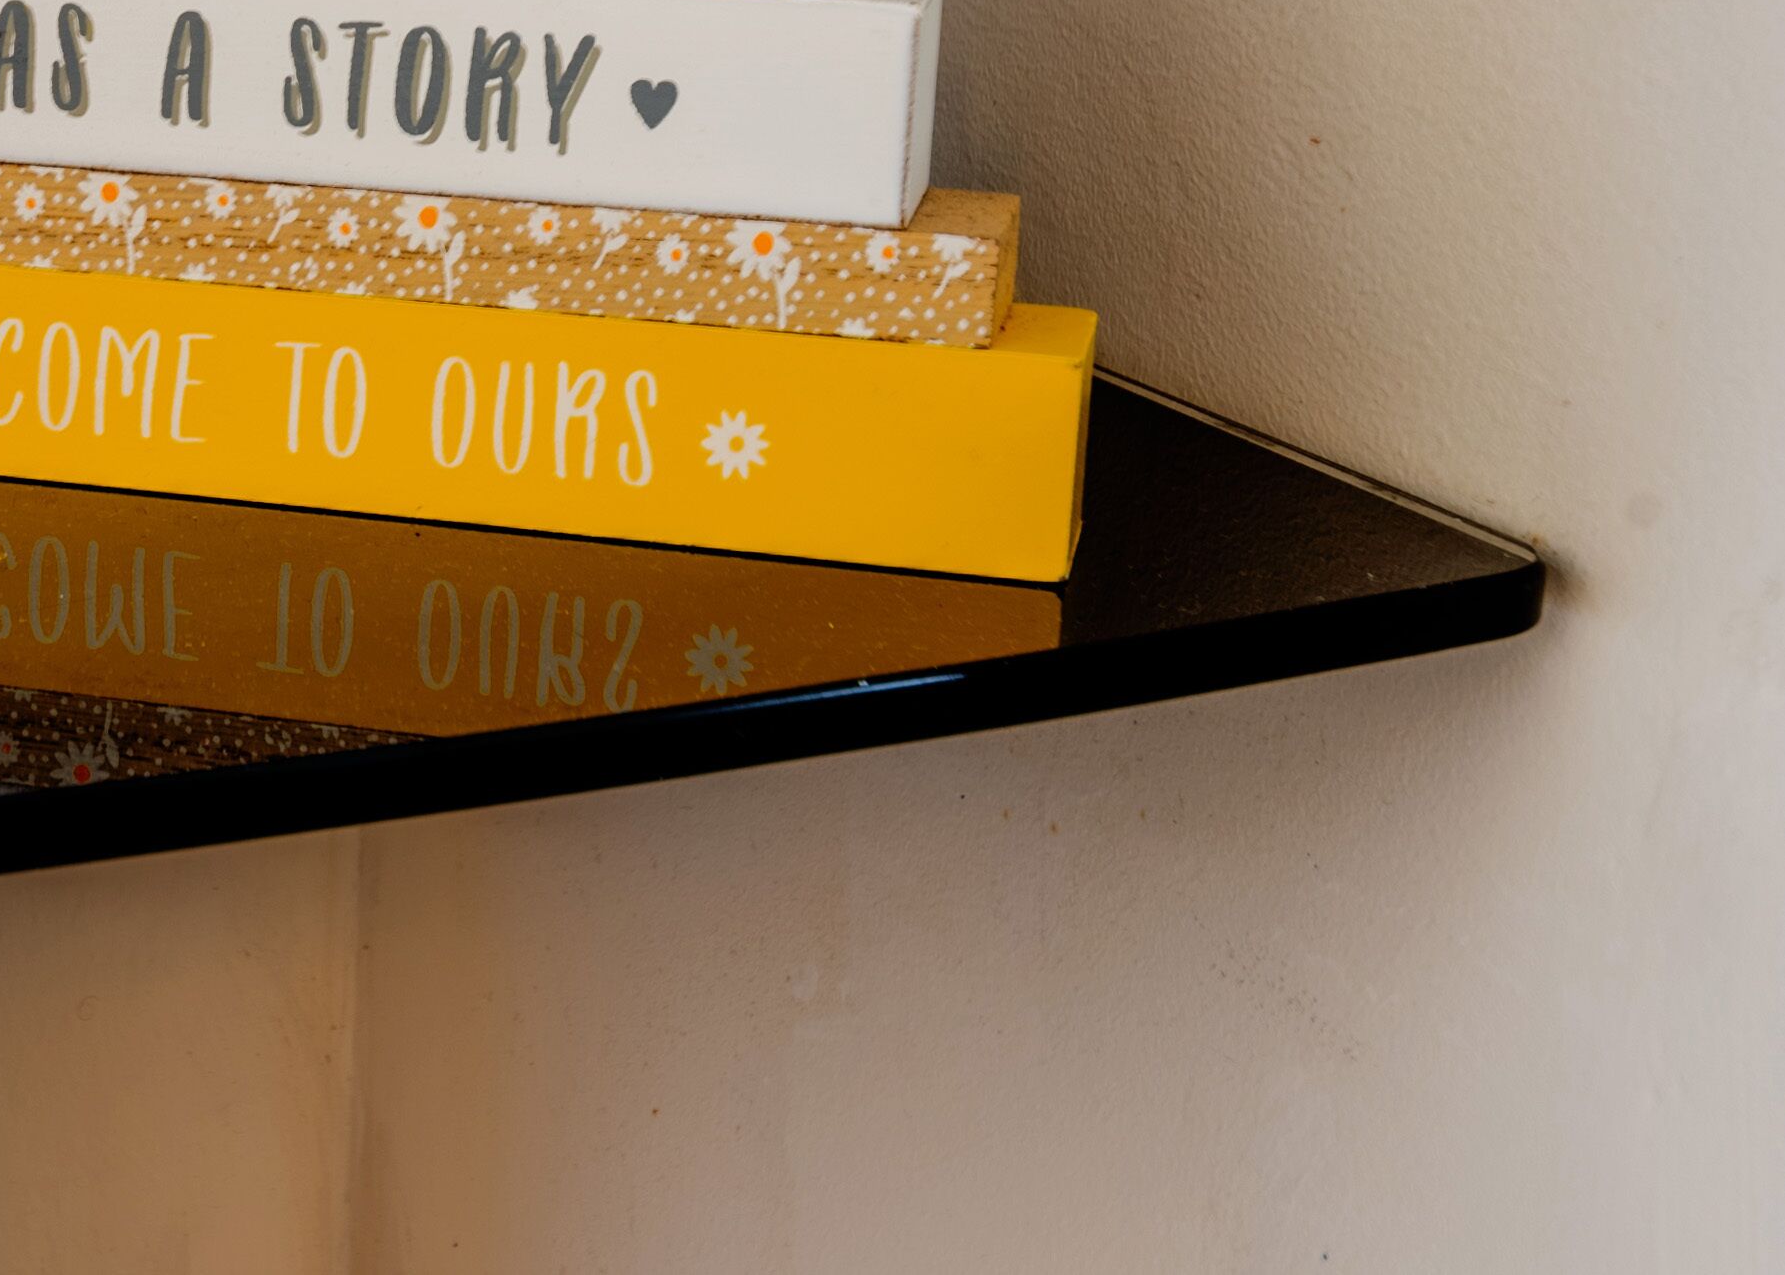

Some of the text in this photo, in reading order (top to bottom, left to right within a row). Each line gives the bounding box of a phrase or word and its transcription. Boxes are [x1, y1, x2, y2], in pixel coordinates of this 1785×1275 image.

[160, 10, 213, 125] A
[282, 16, 606, 157] STORY
[274, 340, 369, 459] TO
[430, 354, 658, 487] OURS
